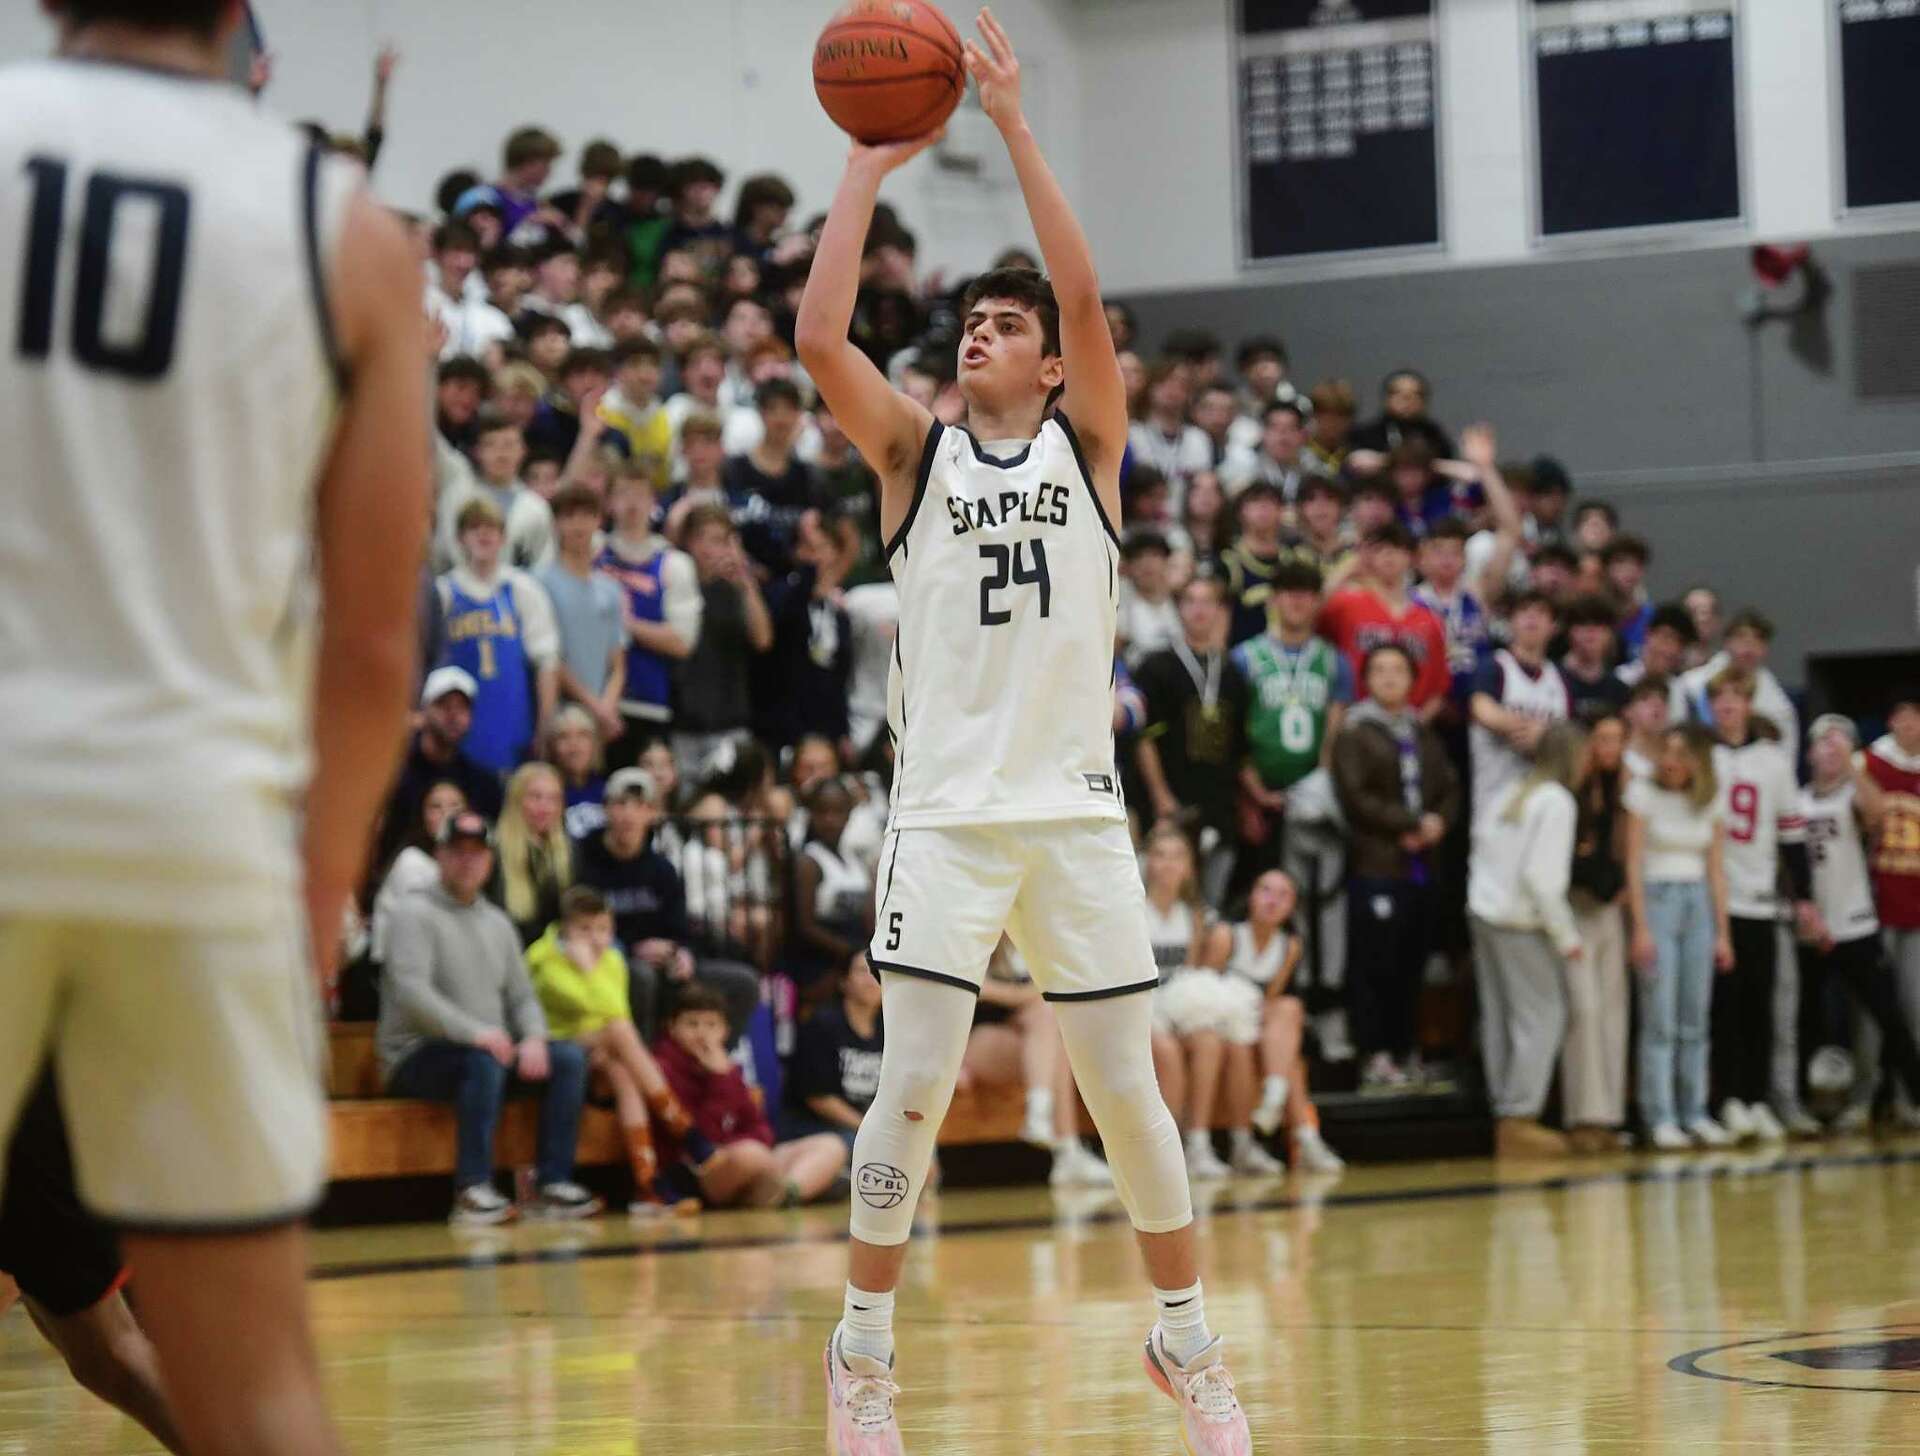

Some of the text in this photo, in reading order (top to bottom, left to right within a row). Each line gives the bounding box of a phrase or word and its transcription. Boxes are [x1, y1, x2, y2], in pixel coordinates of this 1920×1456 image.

[19, 156, 191, 382] 10
[946, 482, 1070, 536] STAPLES
[979, 538, 1050, 626] 24
[1729, 783, 1759, 844] 9
[862, 1172, 903, 1191] EYBL
